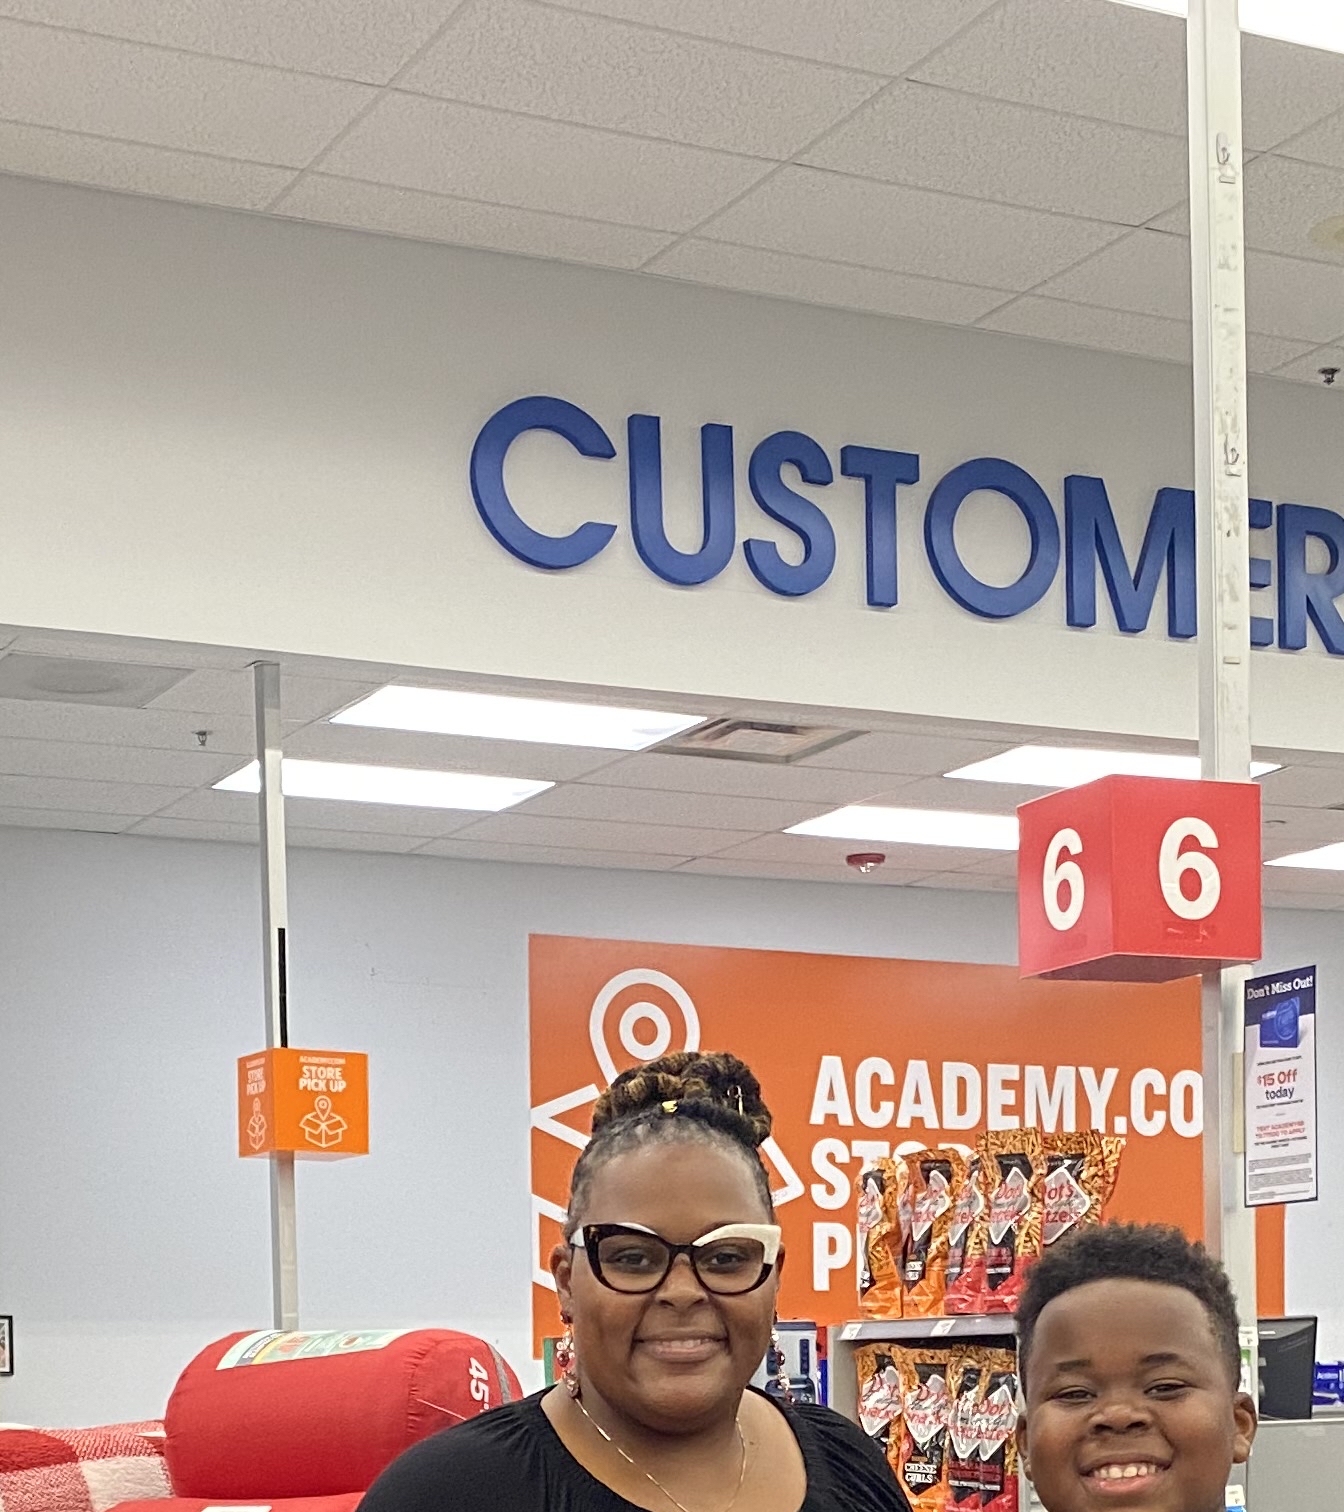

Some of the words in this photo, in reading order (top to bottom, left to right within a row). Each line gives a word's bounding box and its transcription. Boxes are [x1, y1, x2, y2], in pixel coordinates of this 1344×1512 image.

[1042, 827, 1086, 931] 6
[1158, 816, 1221, 920] 6
[1247, 985, 1271, 1000] Don't
[1271, 981, 1292, 995] Miss
[1293, 975, 1314, 991] Out!
[247, 1067, 264, 1083] STORE
[302, 1065, 343, 1081] STORE
[1257, 1071, 1277, 1087] $15
[1277, 1069, 1298, 1085] Off
[298, 1077, 328, 1092] PICK
[329, 1079, 347, 1093] UP
[1265, 1085, 1295, 1101] today
[808, 1055, 1204, 1138] ACADEMY.CO
